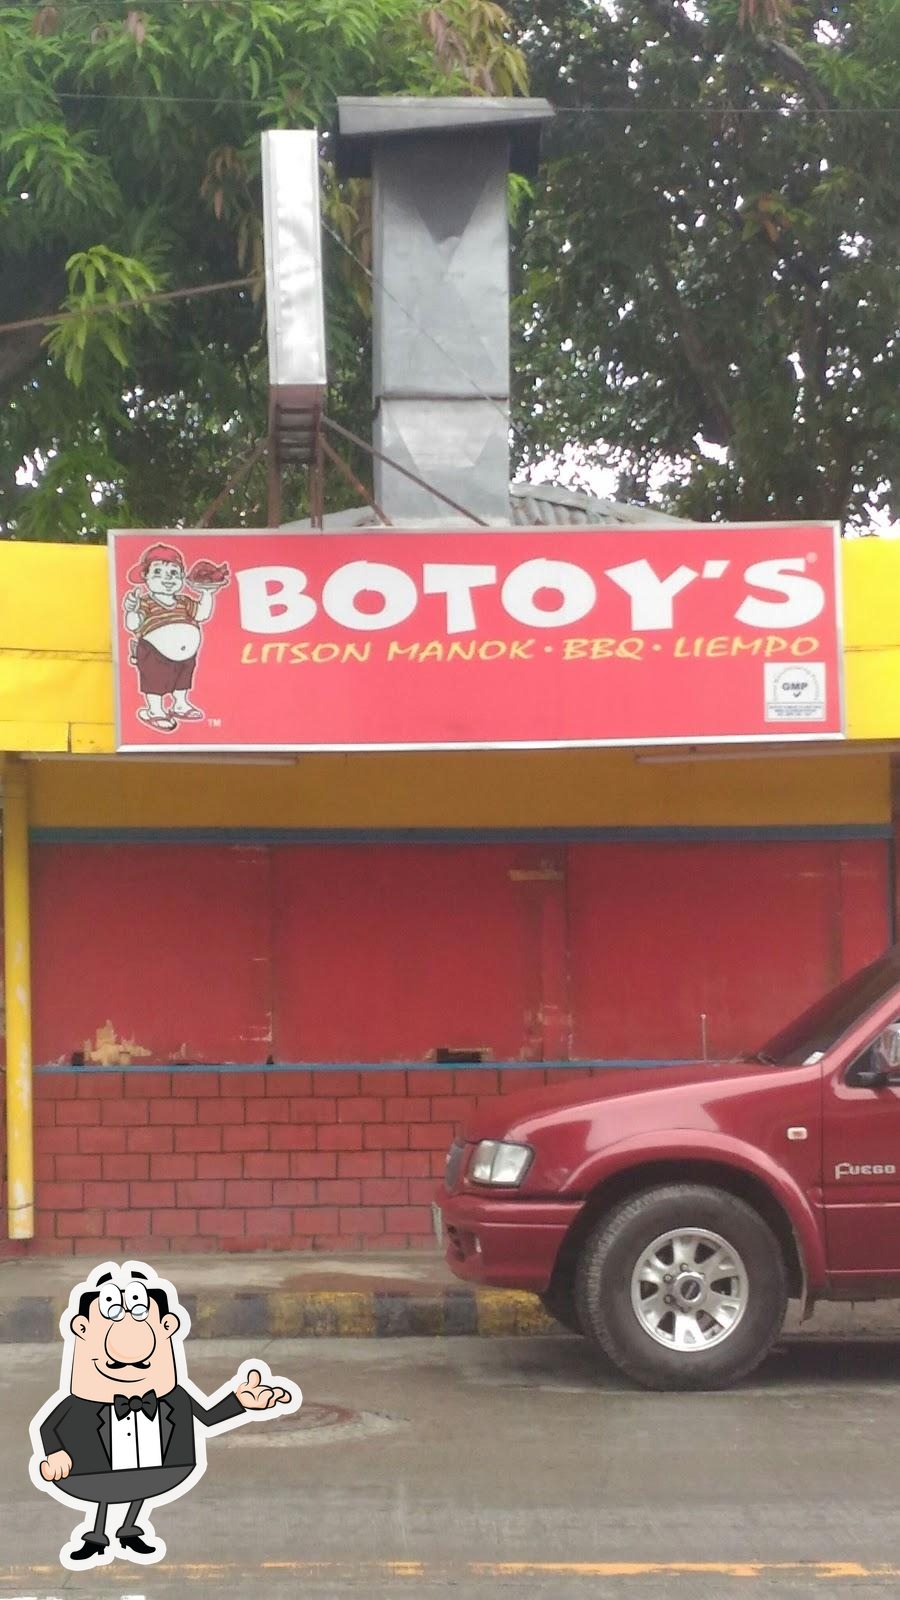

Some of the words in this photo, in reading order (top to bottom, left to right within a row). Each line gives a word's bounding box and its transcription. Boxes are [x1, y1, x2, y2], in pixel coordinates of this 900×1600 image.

[235, 557, 825, 635] BOTOY'S
[240, 640, 371, 665] LITSON
[387, 638, 536, 664] MANOK
[562, 636, 645, 662] BBQ
[673, 635, 820, 659] LIEMPO
[782, 682, 808, 691] GMP
